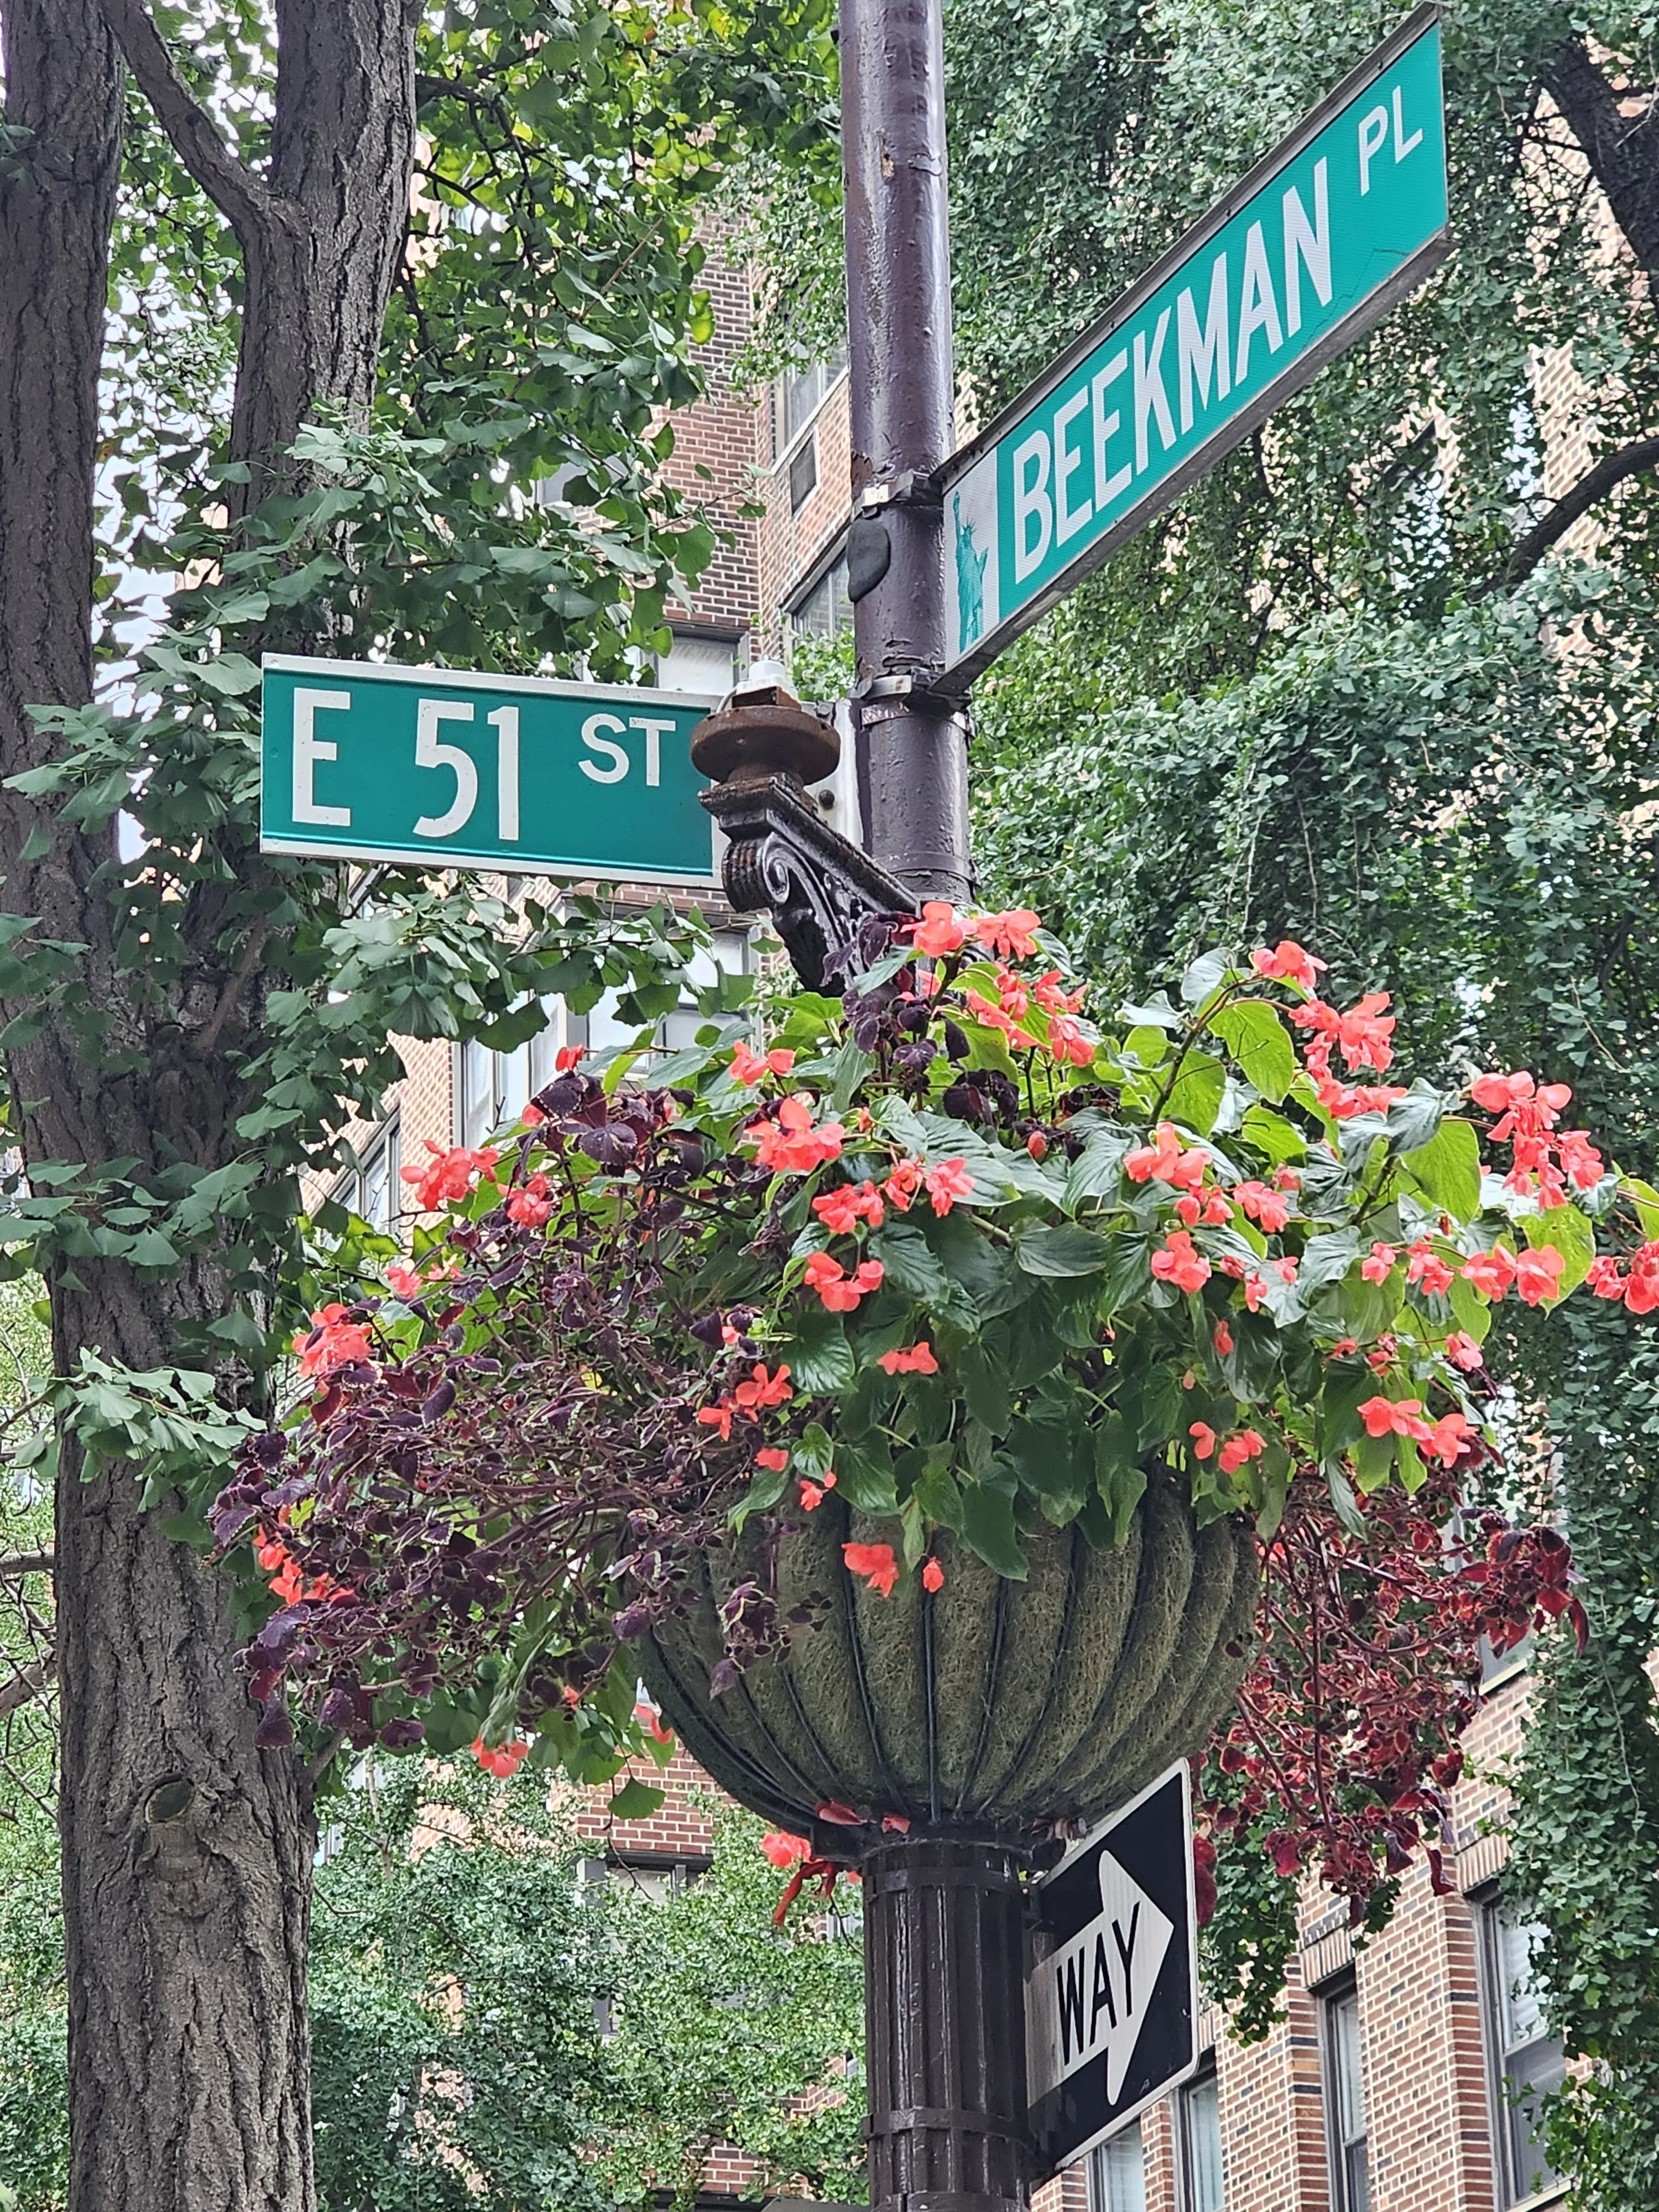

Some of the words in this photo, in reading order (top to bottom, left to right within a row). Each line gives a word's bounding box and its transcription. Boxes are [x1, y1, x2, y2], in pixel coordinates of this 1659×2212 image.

[1014, 156, 1333, 585] BEEKMAN
[1358, 85, 1423, 196] PL
[291, 687, 351, 827] E
[413, 698, 520, 841] 51
[577, 713, 676, 787] ST
[1056, 1901, 1140, 2067] WAY
